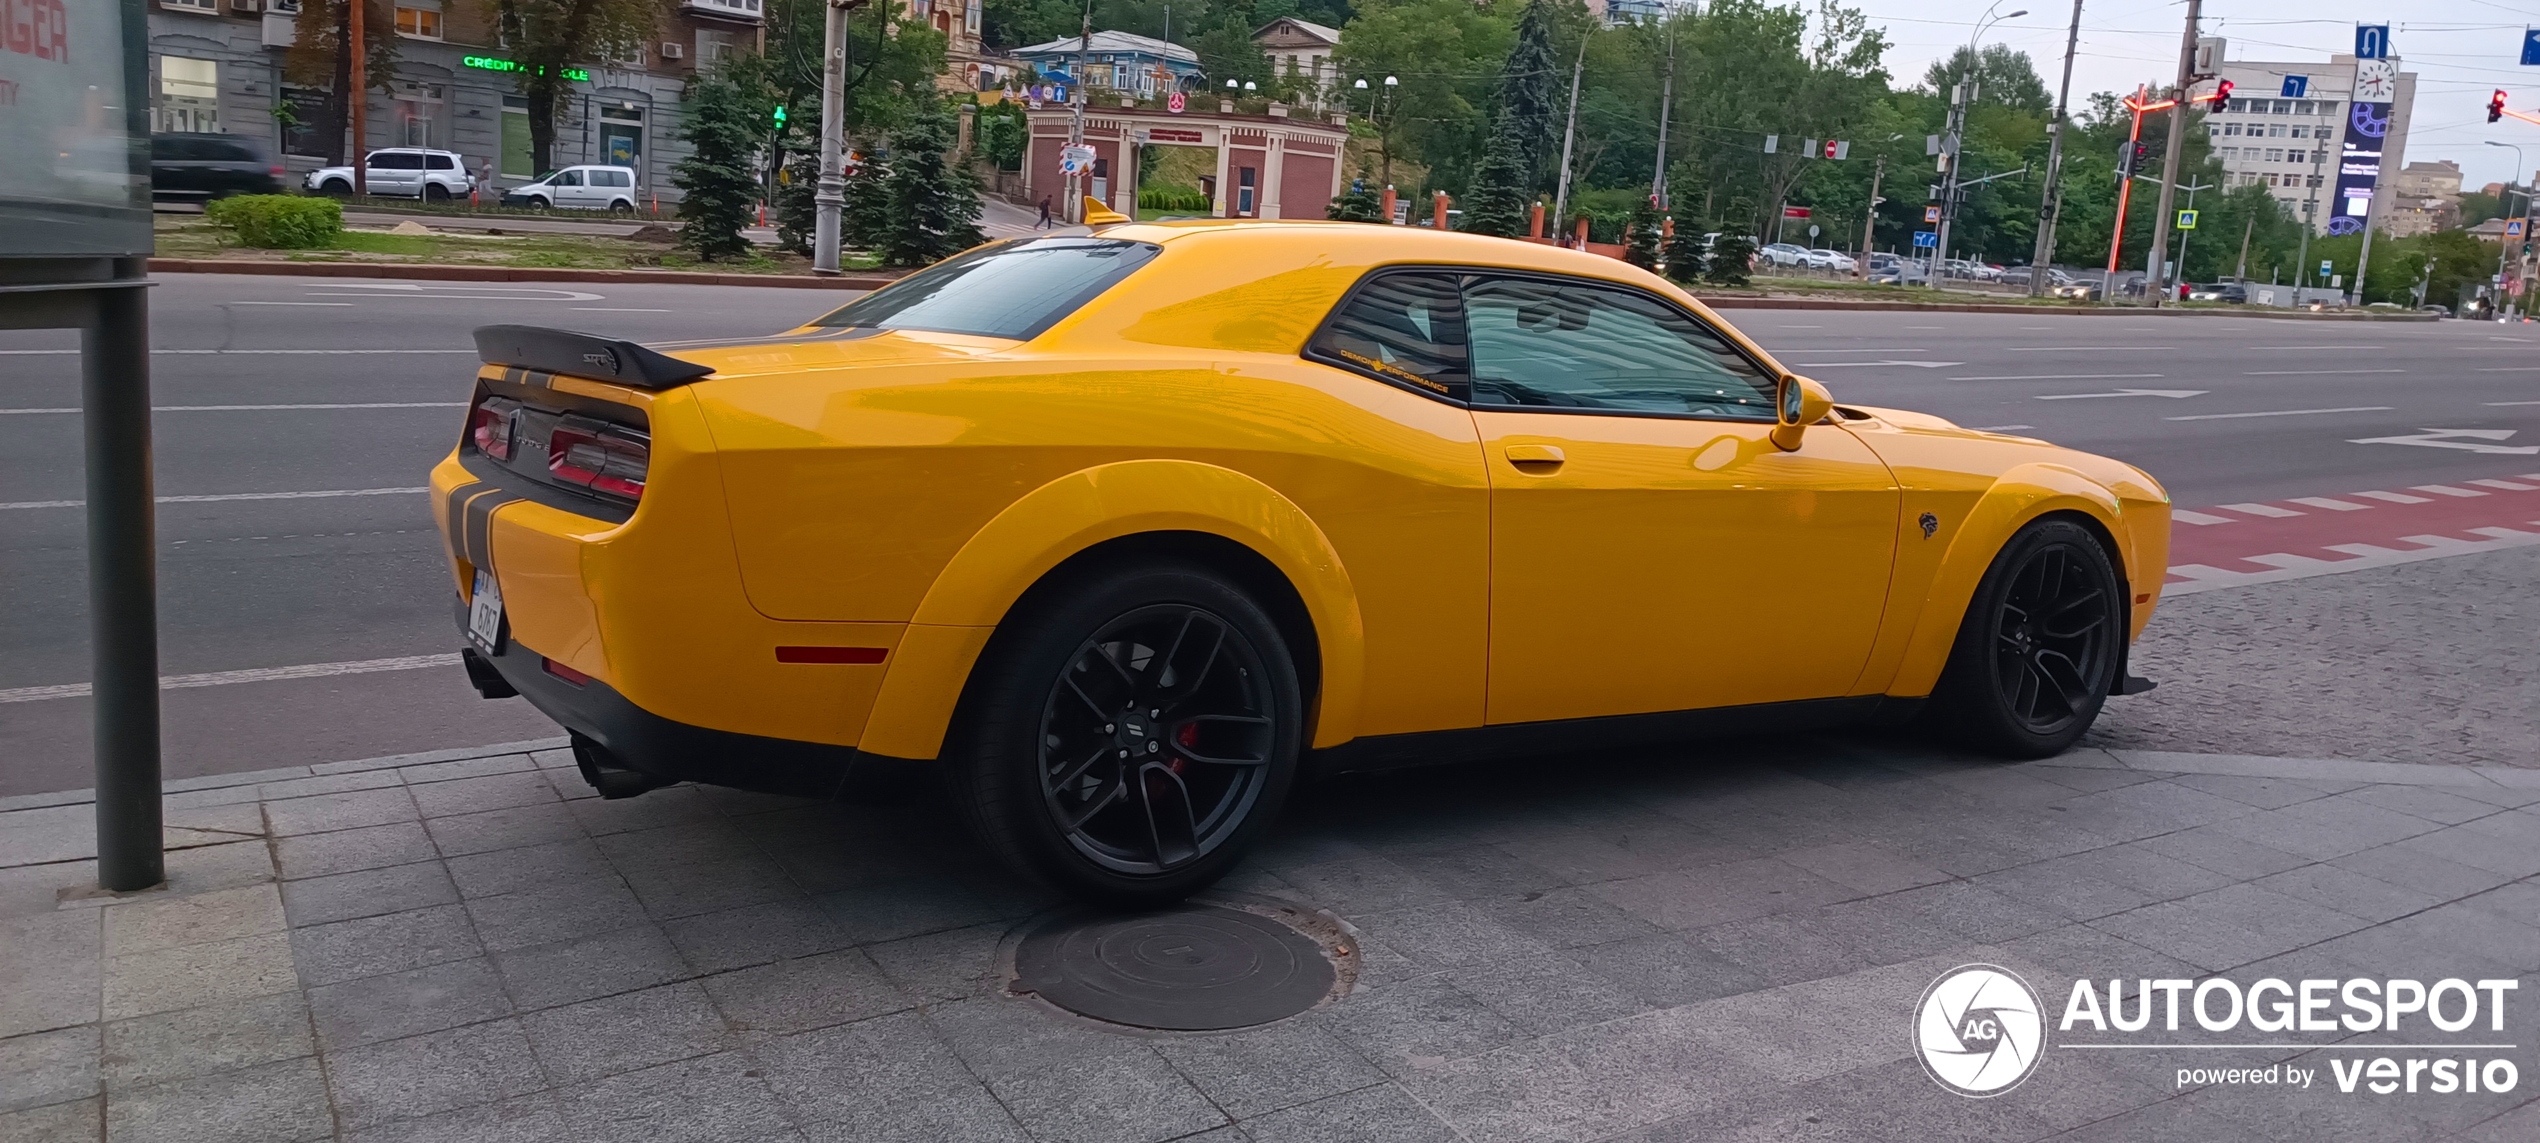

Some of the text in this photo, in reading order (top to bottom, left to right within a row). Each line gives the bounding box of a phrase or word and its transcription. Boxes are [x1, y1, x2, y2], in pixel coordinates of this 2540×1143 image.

[0, 0, 68, 64] GER
[1340, 349, 1449, 394] DEMON PERFORMANCE
[478, 602, 498, 639] 6767
